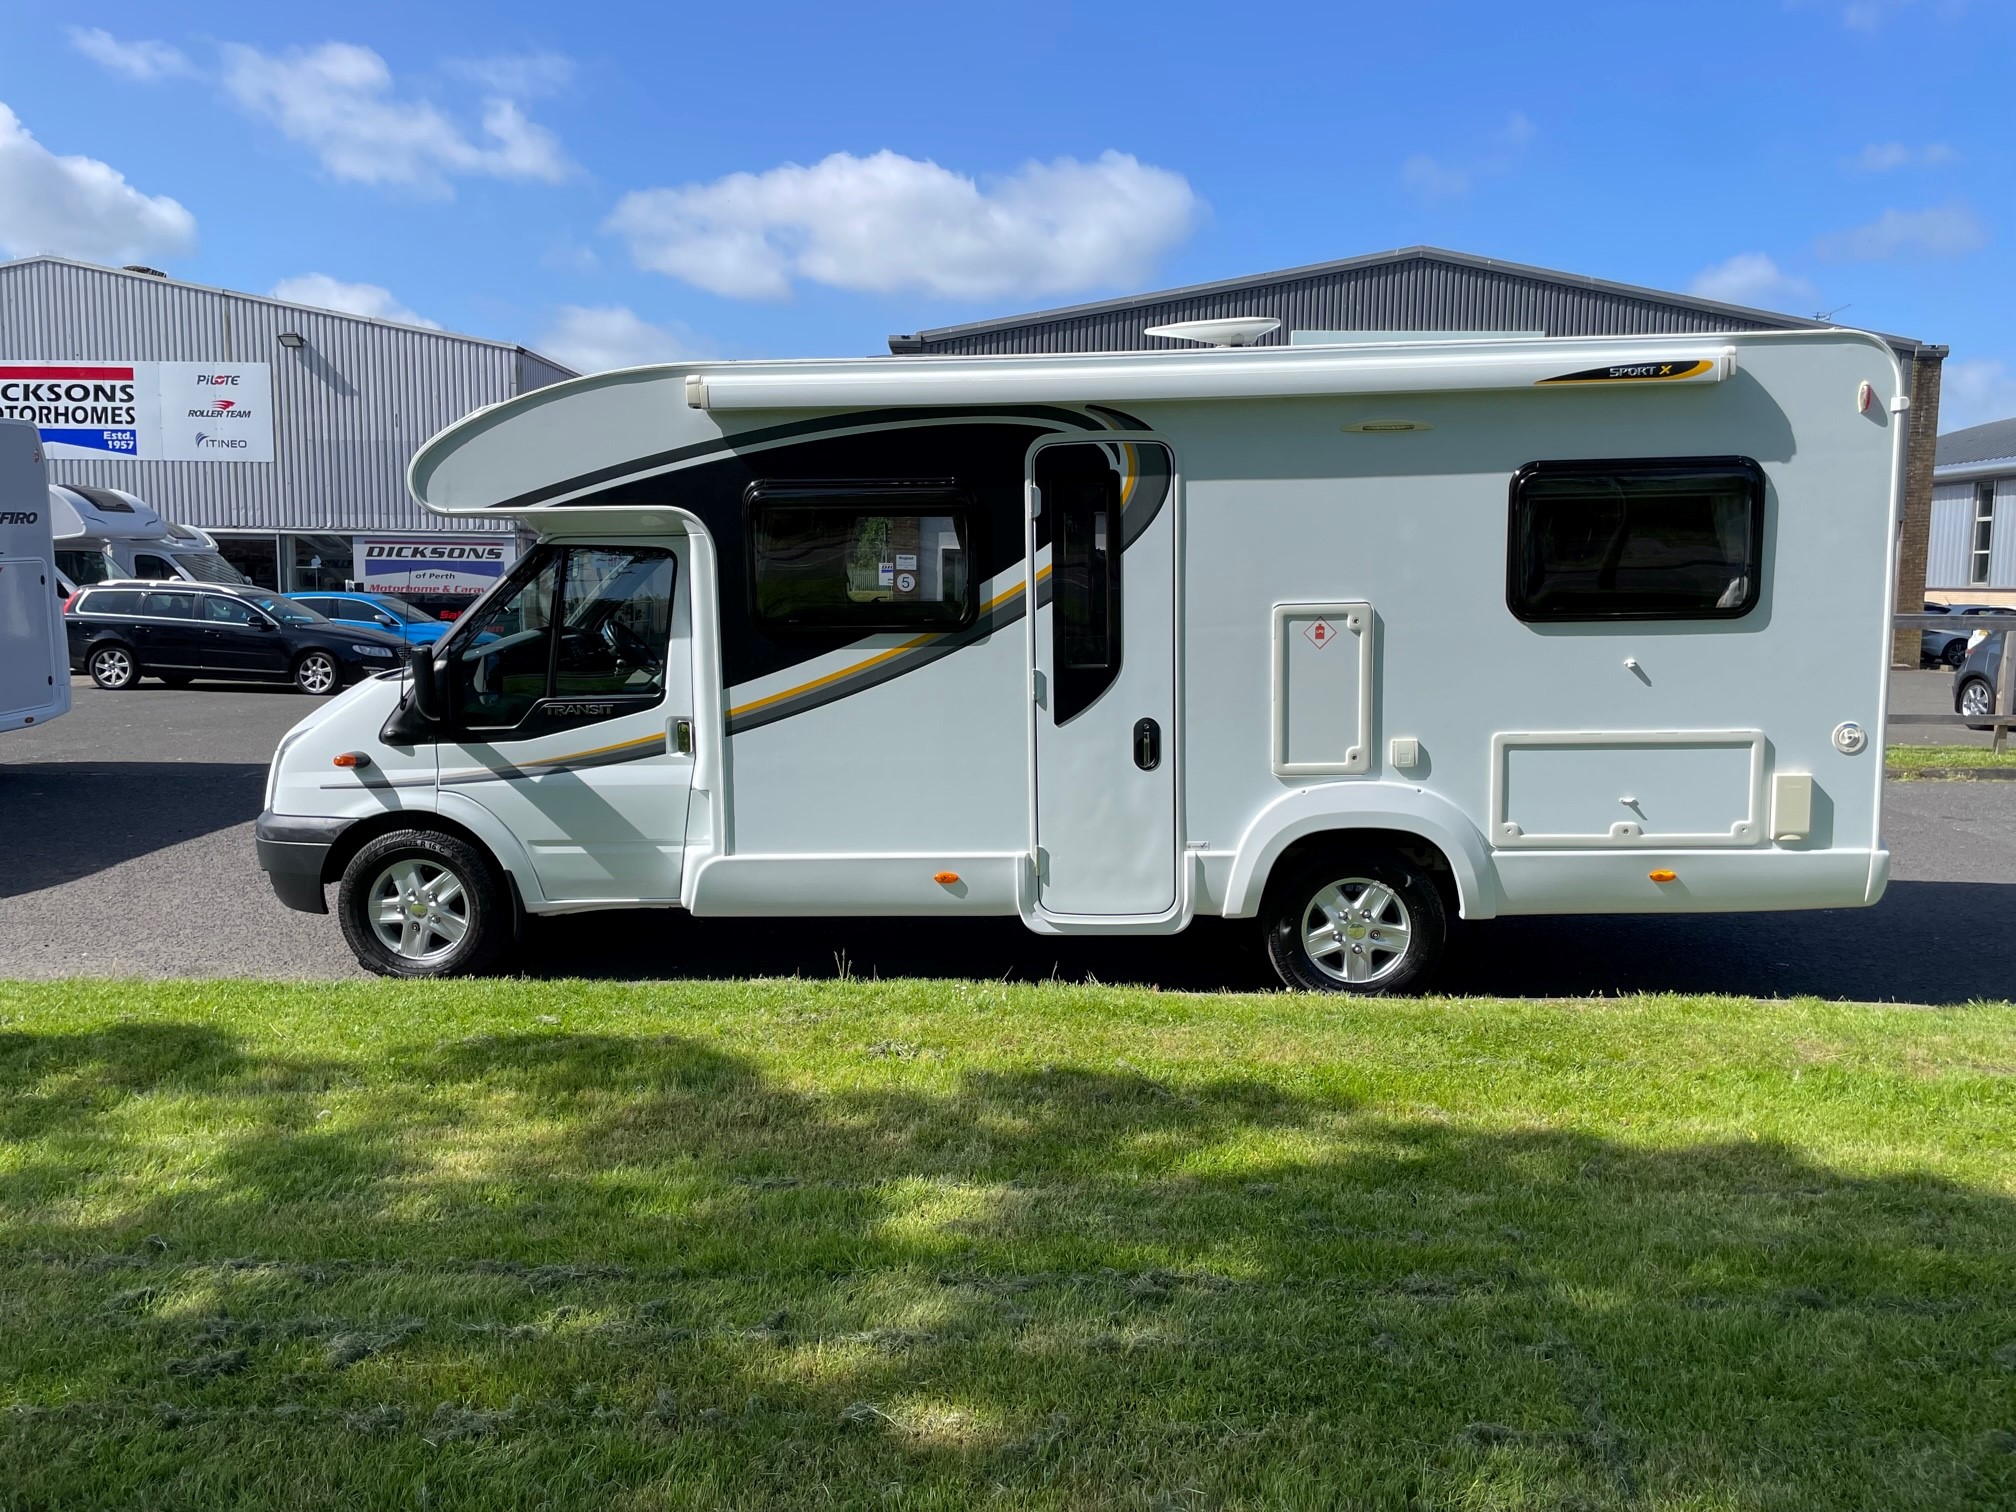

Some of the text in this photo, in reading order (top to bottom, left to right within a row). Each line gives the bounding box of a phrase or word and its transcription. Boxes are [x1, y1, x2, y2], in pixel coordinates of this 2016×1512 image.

[1609, 365, 1673, 377] SPORT X
[0, 383, 135, 402] CKSONS
[0, 404, 136, 425] TORHOMES
[188, 410, 251, 419] ROLLER TEAM
[103, 431, 134, 440] Estd.
[107, 440, 135, 450] 1957
[206, 439, 248, 448] ITINEO
[0, 512, 38, 525] FIRO
[366, 546, 504, 559] DICKSONS
[415, 572, 456, 580] of Perth
[902, 576, 910, 589] 5
[370, 584, 440, 593] Motorhome
[442, 585, 453, 593] &
[543, 704, 613, 715] TRANSIT
